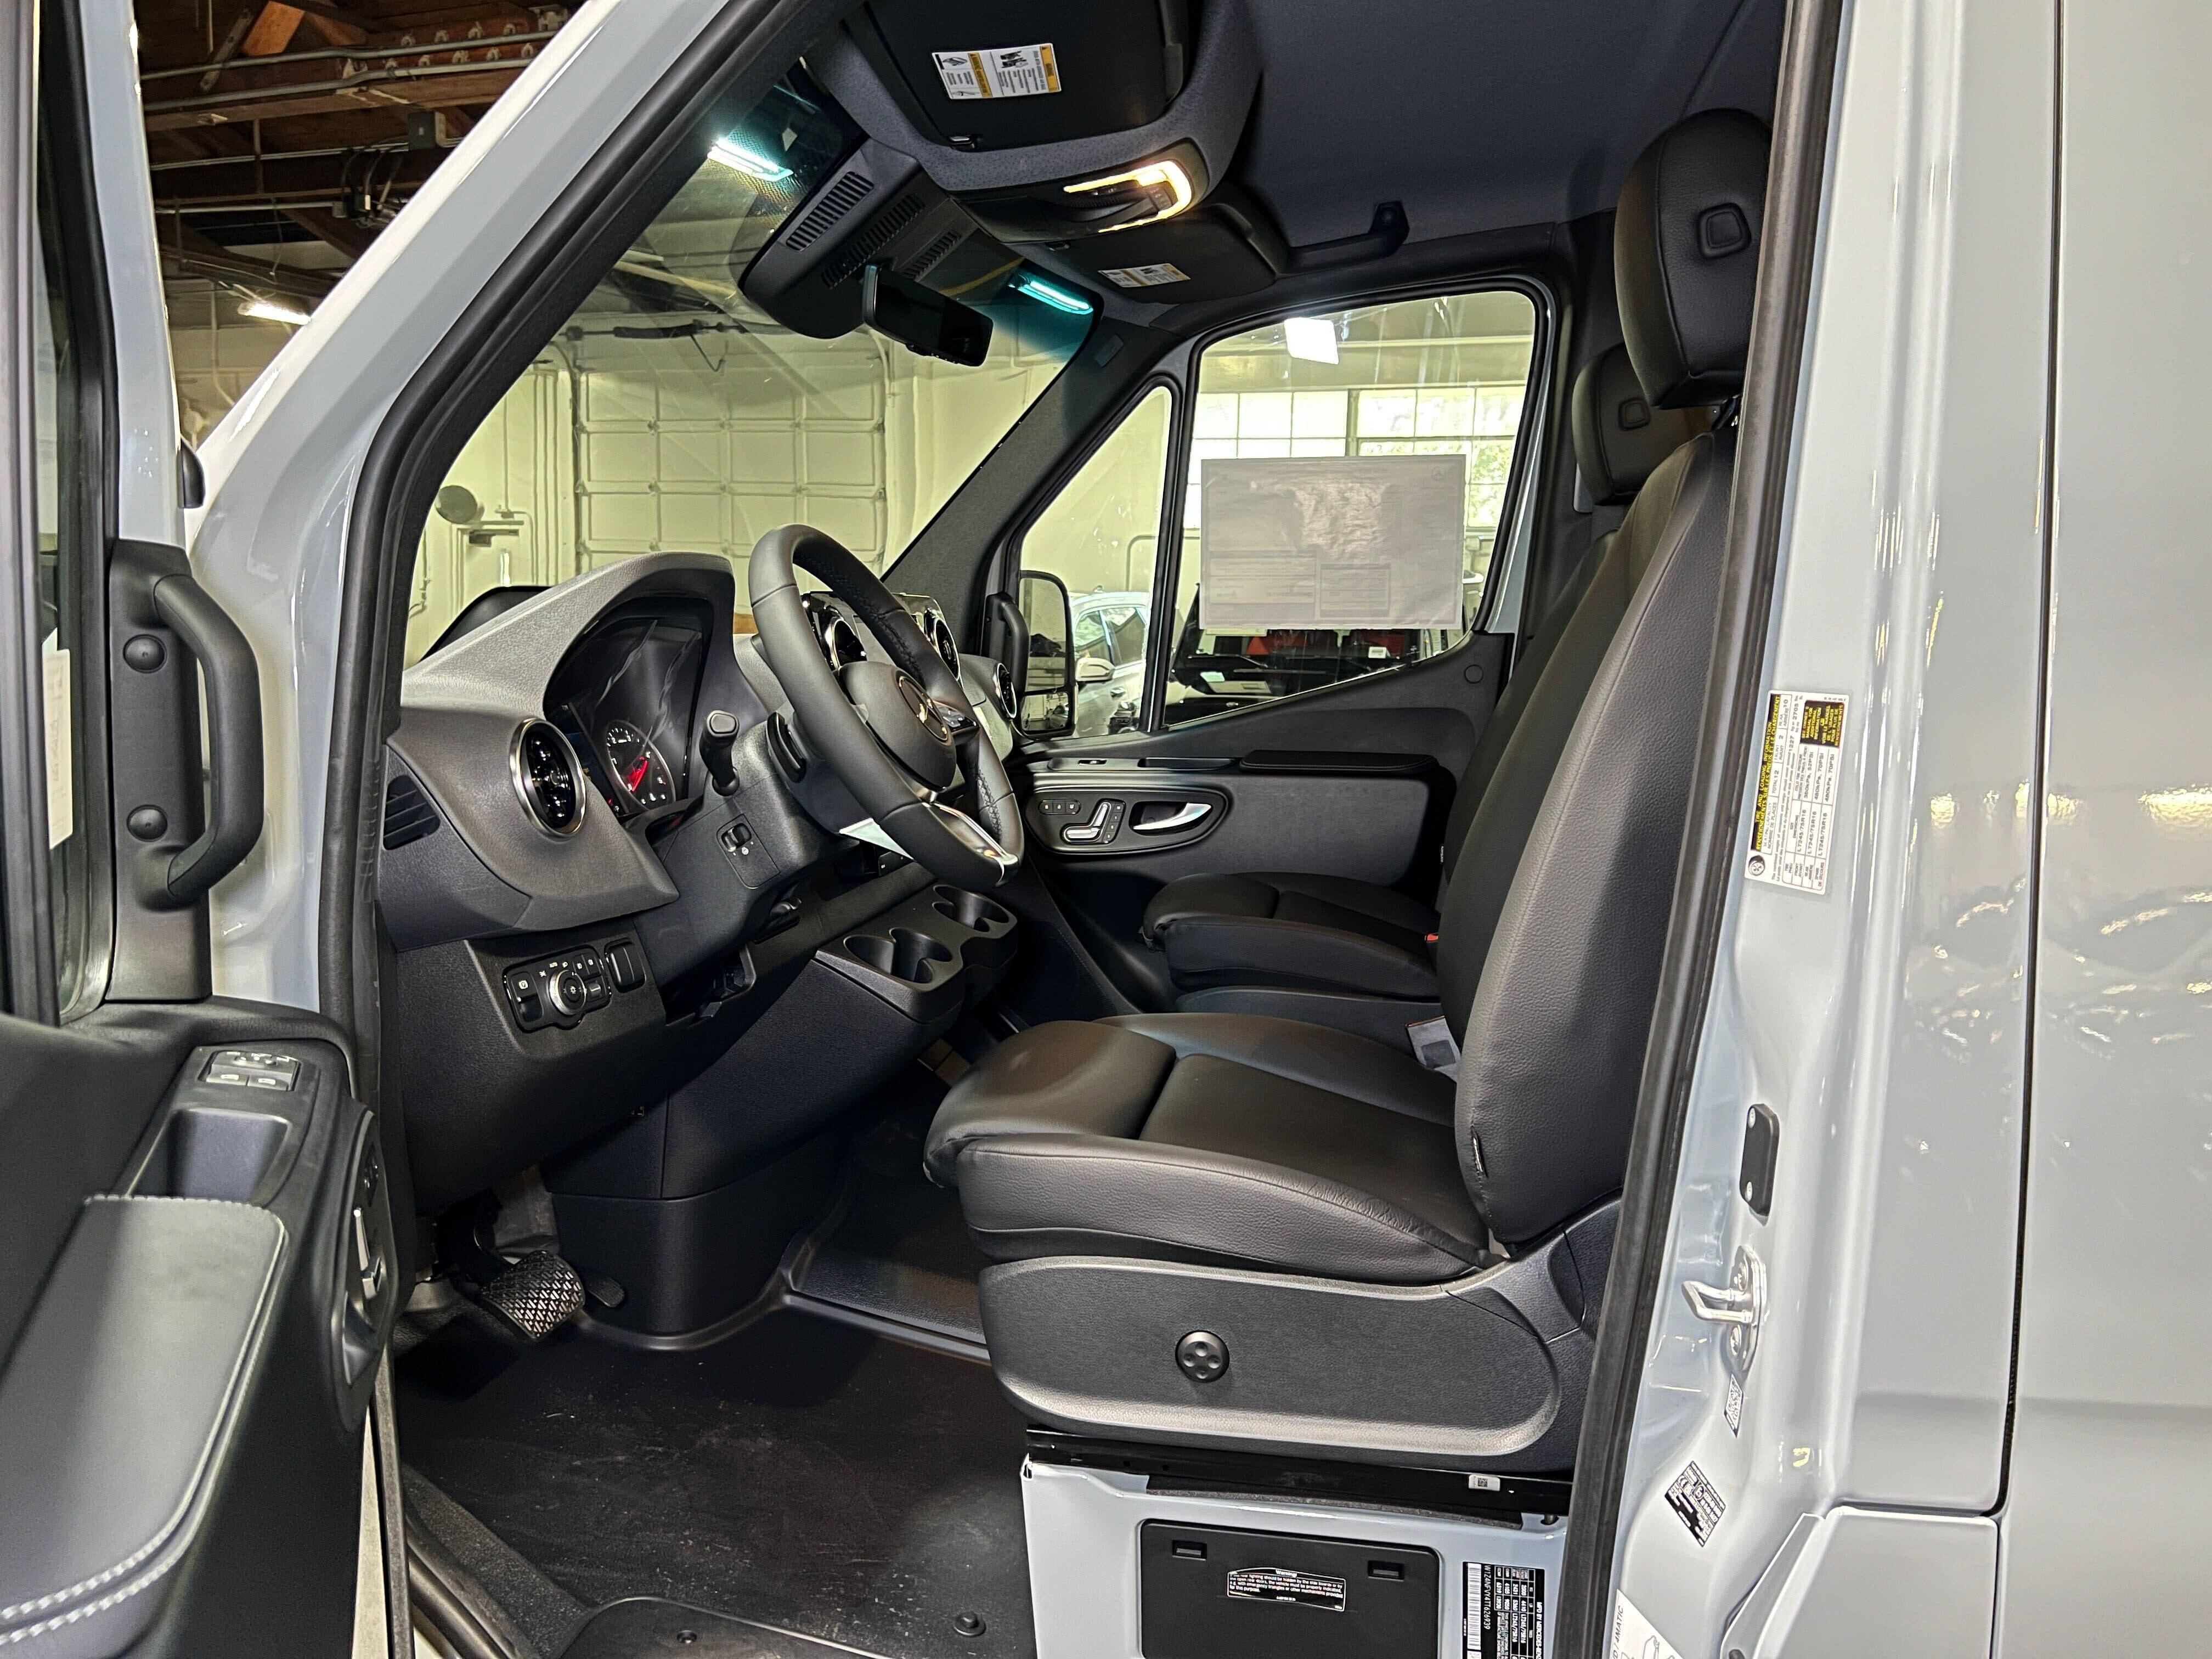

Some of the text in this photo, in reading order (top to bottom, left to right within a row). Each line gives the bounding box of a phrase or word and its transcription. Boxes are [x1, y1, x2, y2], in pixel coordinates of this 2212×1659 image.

[1782, 699, 1788, 707] 10
[1763, 721, 1772, 761] INFORMATION
[1756, 799, 1767, 850] RENSEIGNEMENTS
[1771, 696, 1780, 735] CHARGEMENT
[1773, 770, 1779, 778] 12
[1615, 1605, 1623, 1643] 4MATIC
